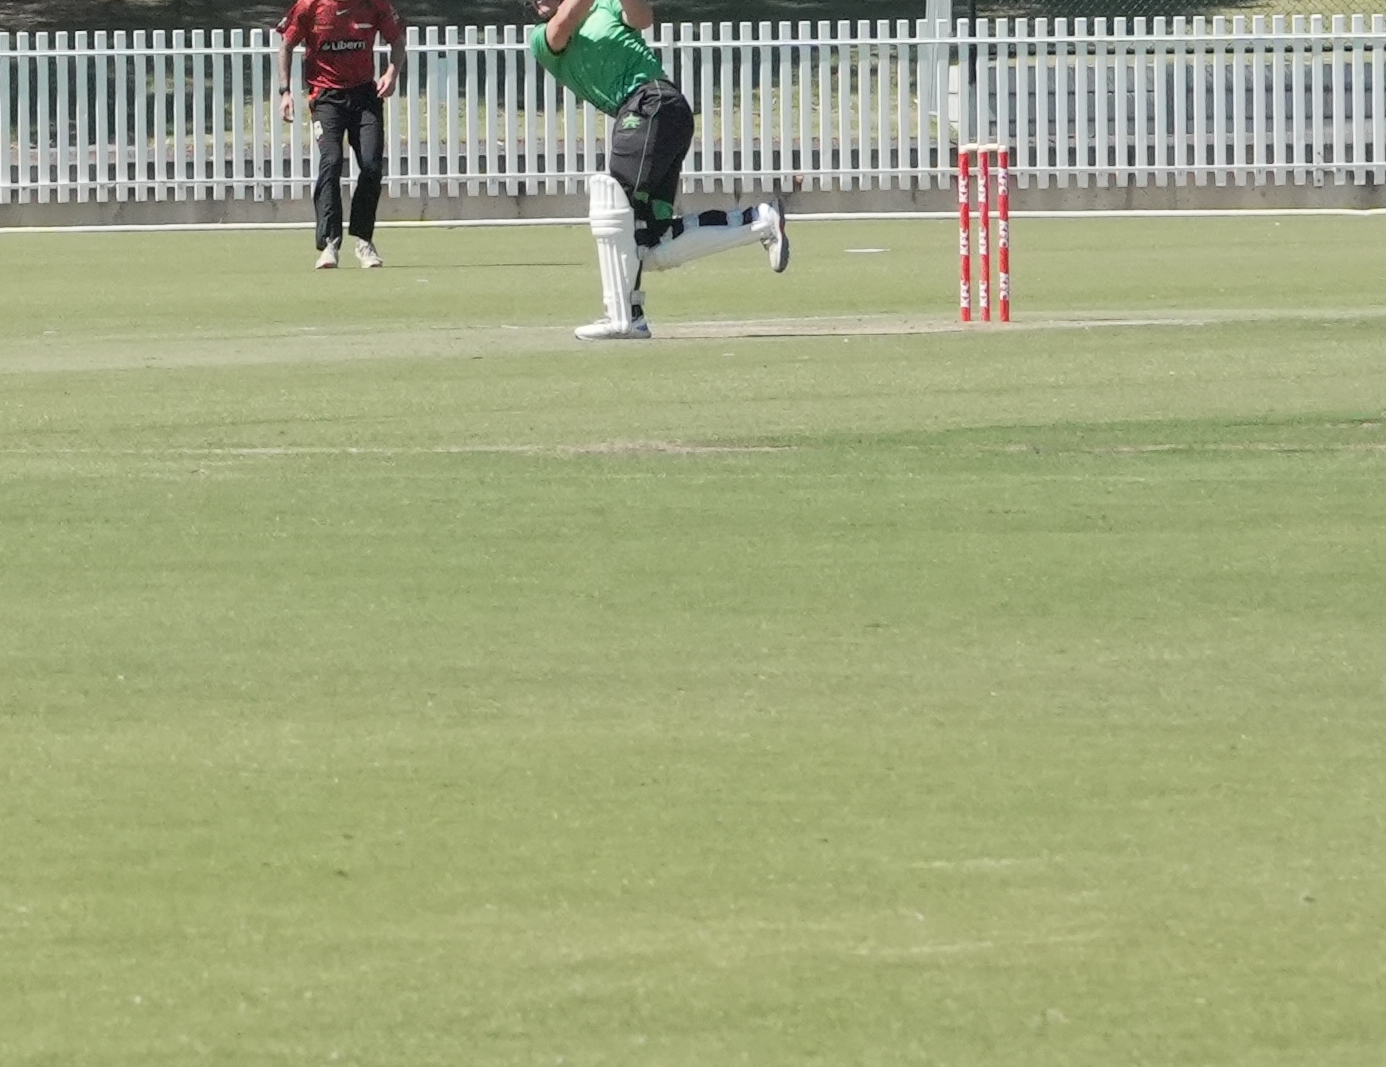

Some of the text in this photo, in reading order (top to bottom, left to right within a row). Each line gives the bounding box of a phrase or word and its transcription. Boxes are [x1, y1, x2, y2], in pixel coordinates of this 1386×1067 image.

[958, 175, 968, 203] KFC
[978, 175, 986, 203] KFC
[998, 167, 1008, 195] KFC
[959, 228, 969, 255] KFC
[979, 227, 987, 255] KFC
[998, 220, 1008, 248] KFC
[960, 280, 969, 308] KFC
[979, 280, 987, 308] KFC
[999, 272, 1009, 300] KFC
